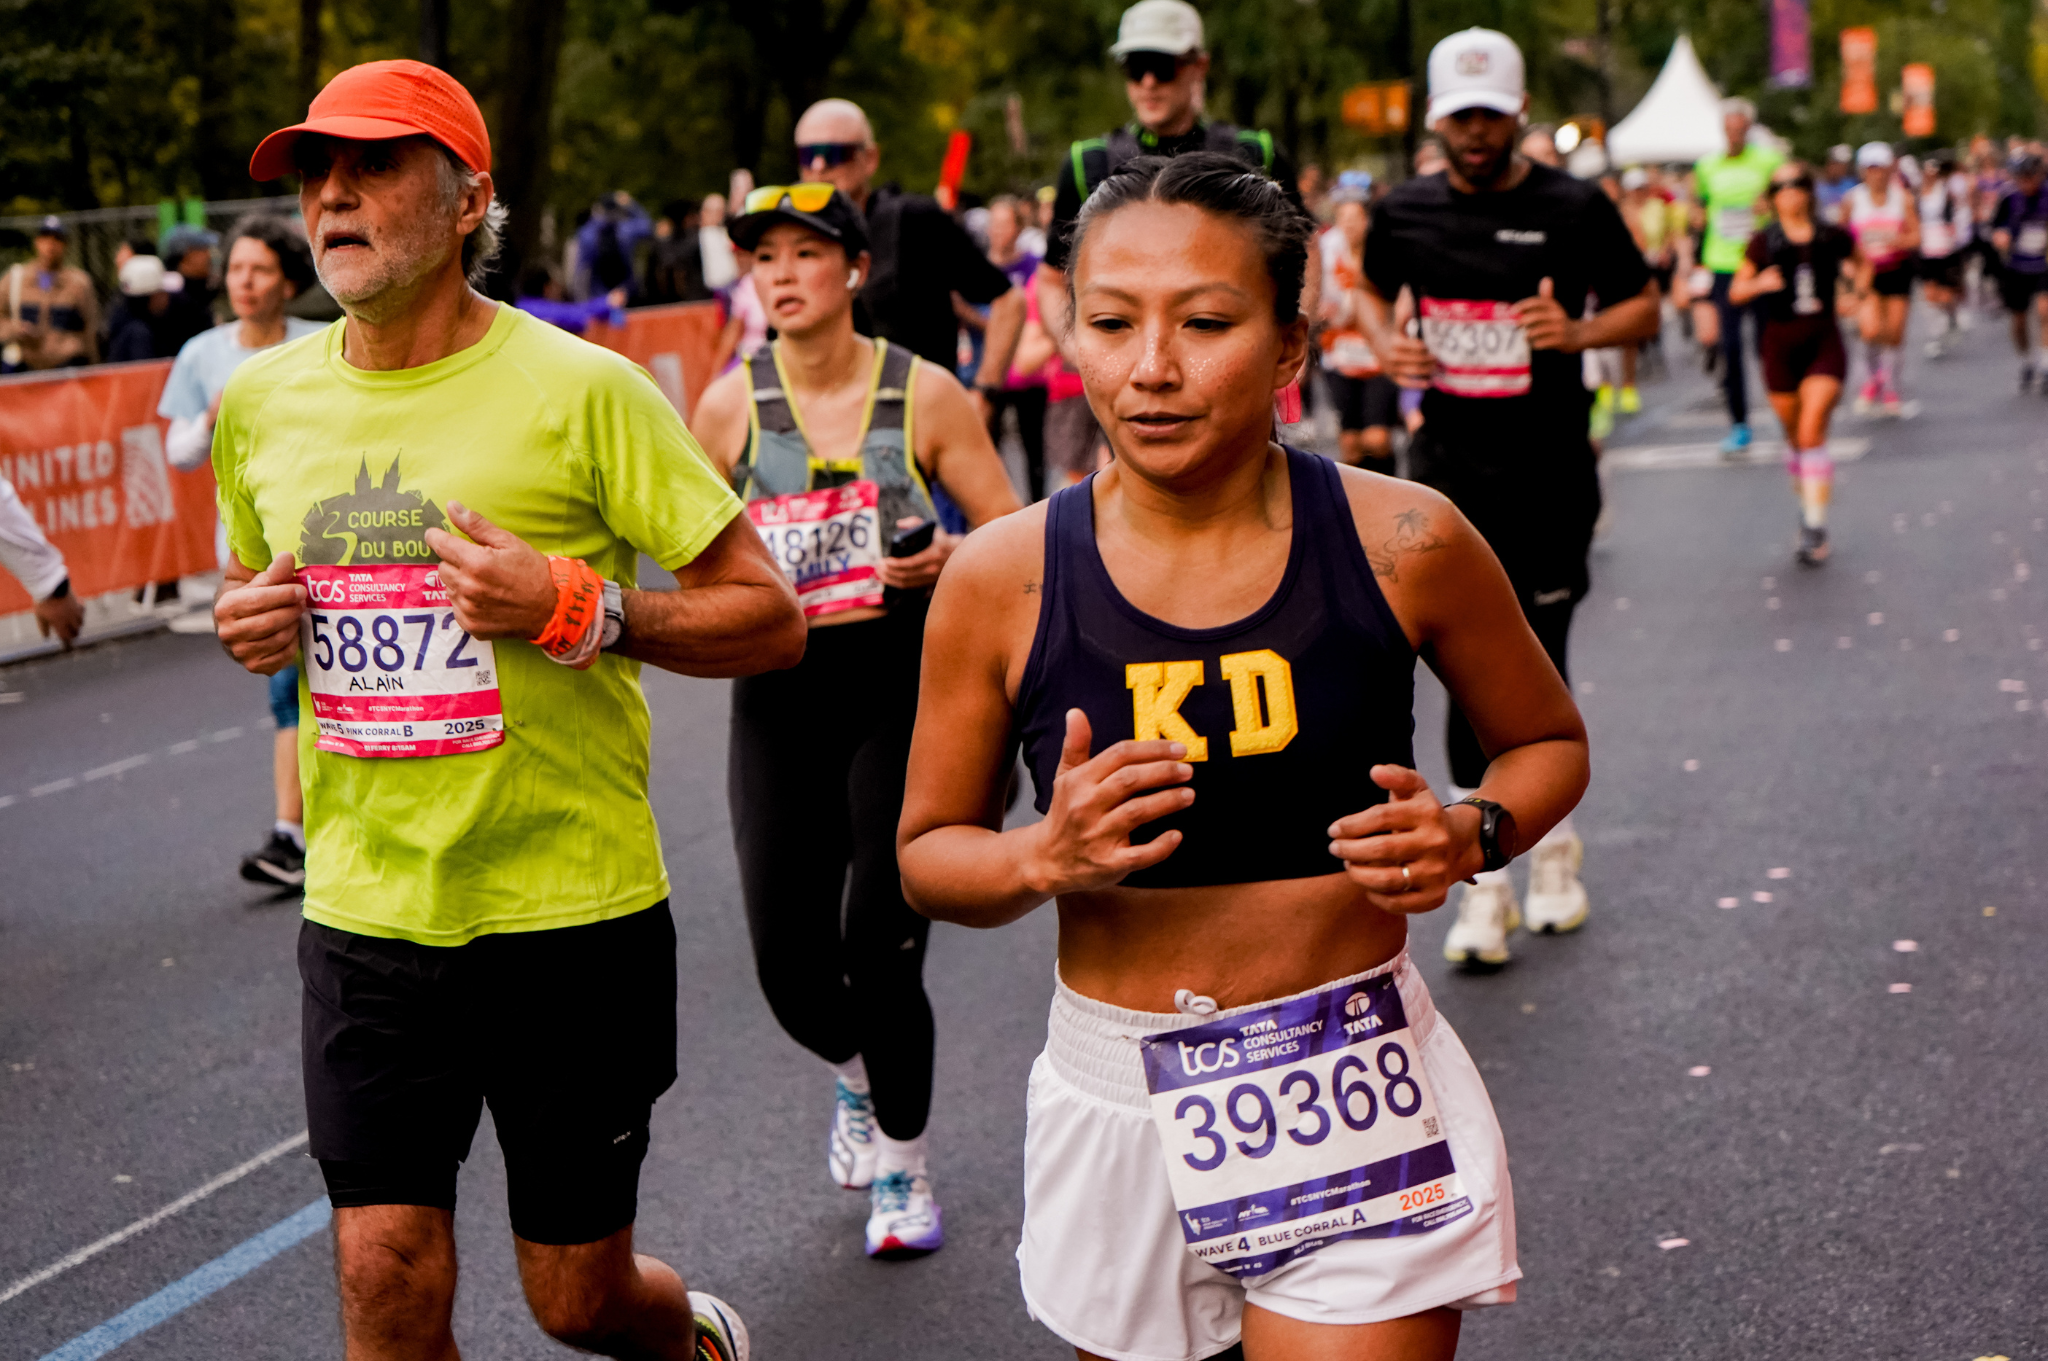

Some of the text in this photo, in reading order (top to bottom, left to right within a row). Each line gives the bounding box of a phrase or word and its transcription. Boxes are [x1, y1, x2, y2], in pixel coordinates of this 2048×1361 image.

[348, 509, 423, 528] COURSE
[361, 541, 385, 558] DU
[306, 574, 346, 603] tcs
[348, 573, 373, 582] TATA
[349, 583, 406, 593] CONSULTANCY
[349, 593, 387, 603] SERVICES
[422, 590, 449, 600] TAT
[311, 612, 478, 673] 58872
[337, 723, 345, 735] 5
[346, 727, 363, 736] PINK
[365, 728, 401, 736] CORRAL
[403, 725, 414, 737] B
[444, 719, 485, 735] 2025
[1239, 1019, 1278, 1037] TATA
[1243, 1020, 1324, 1050] CONSULTANCY
[1343, 1014, 1384, 1037] TATA
[1177, 1038, 1241, 1077] tcs
[1246, 1040, 1300, 1064] SERVICES
[1174, 1041, 1423, 1172] 39368
[1290, 1179, 1372, 1206] #TCSNYCMarathon
[1399, 1183, 1446, 1211] 2025
[1195, 1208, 1367, 1258] WAVE 4 BLUE CORRAL A
